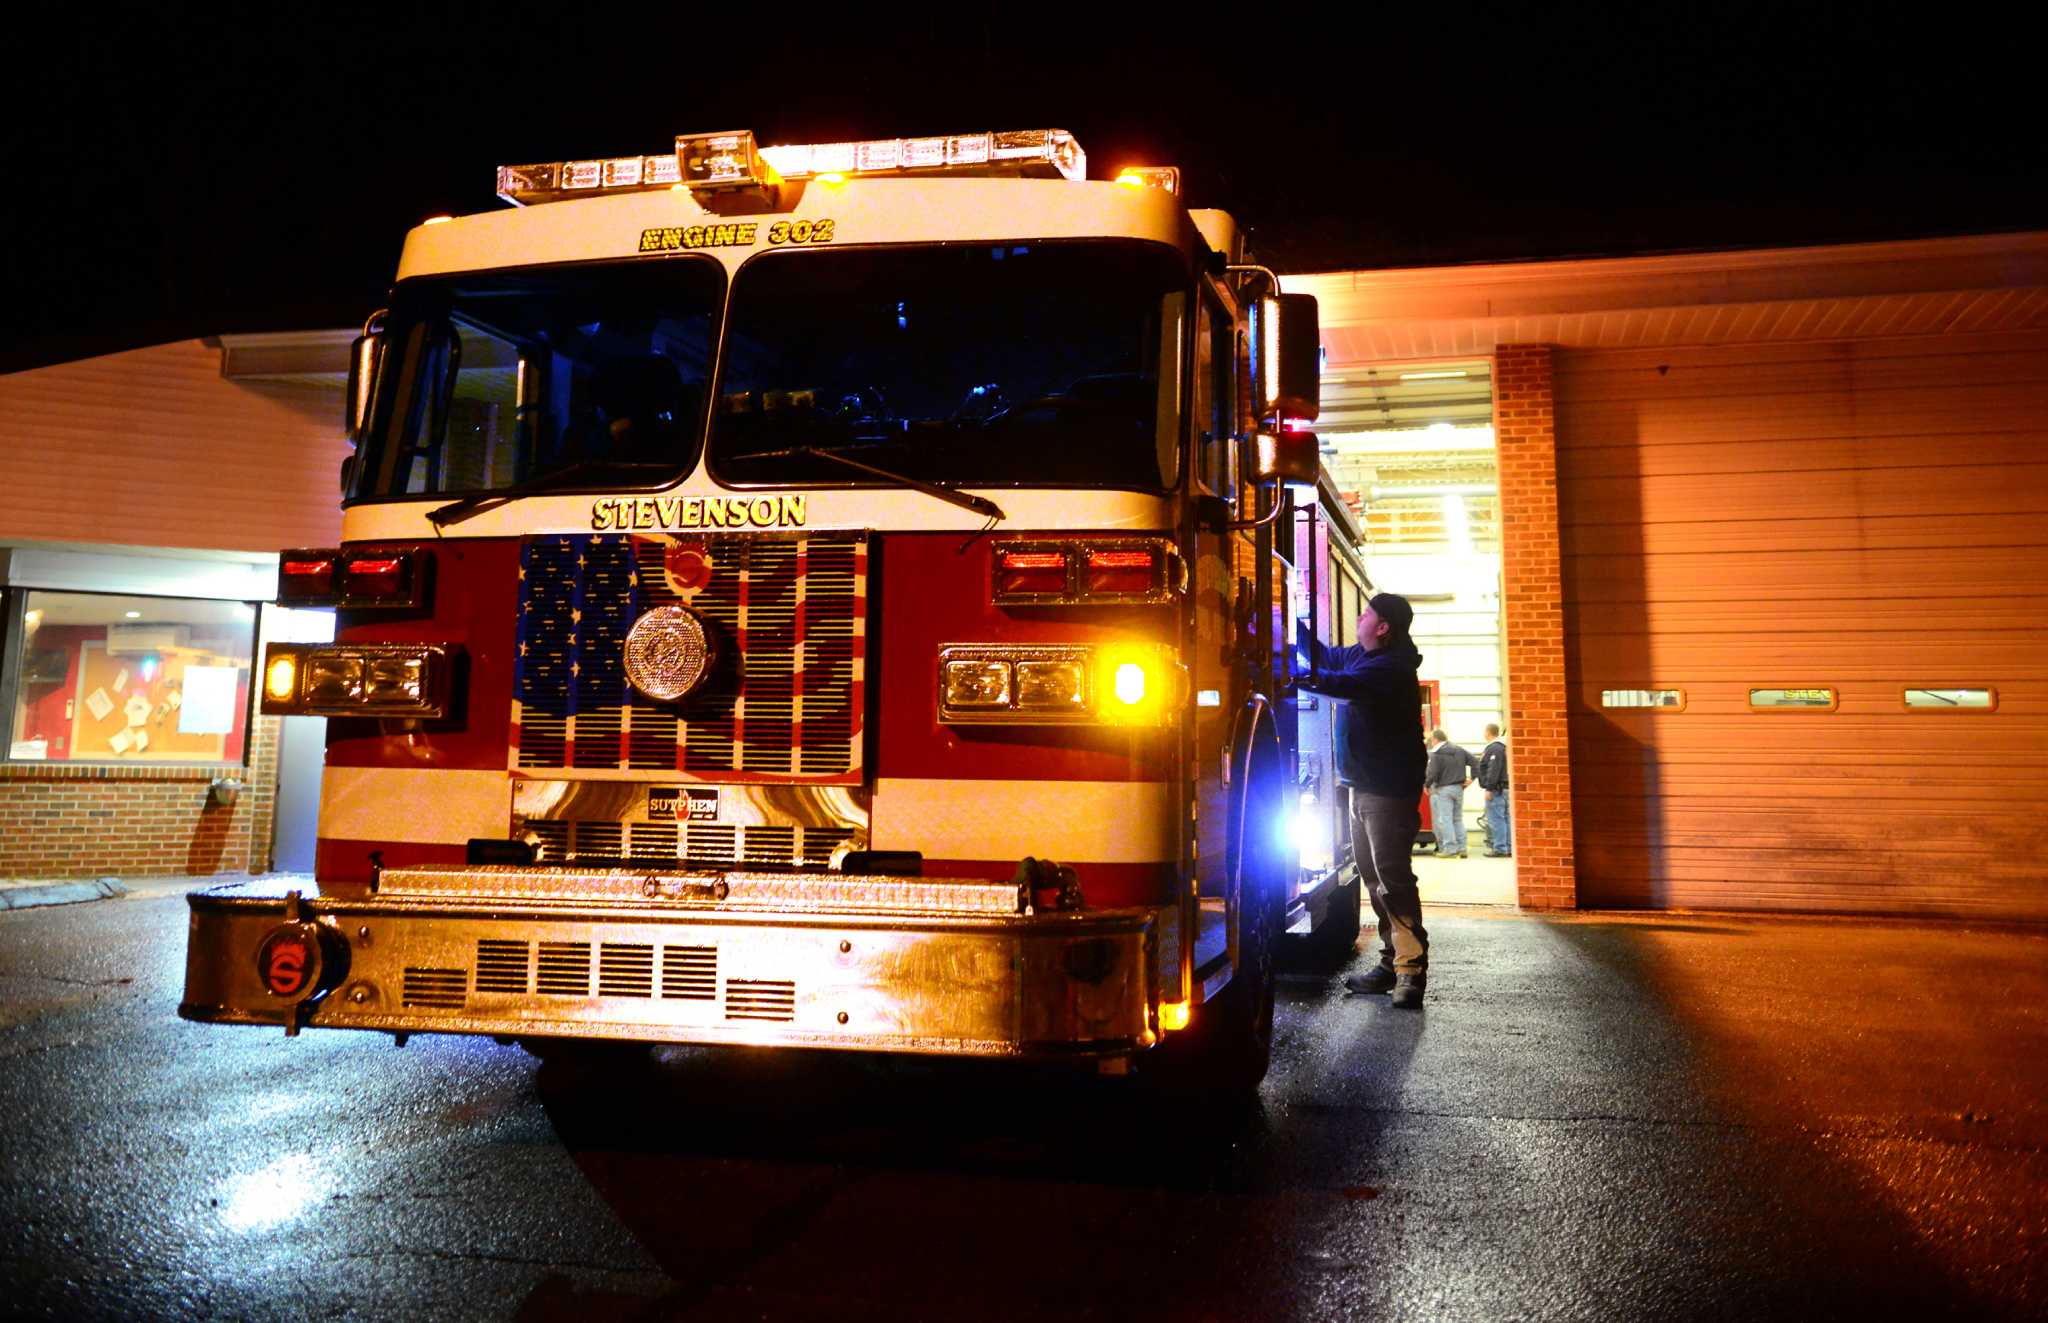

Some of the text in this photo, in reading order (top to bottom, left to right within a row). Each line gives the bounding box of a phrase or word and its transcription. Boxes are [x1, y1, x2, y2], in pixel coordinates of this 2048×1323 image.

[639, 219, 836, 252] ENGINE 302
[592, 494, 807, 530] STEVENSON
[650, 799, 718, 812] SUTPHEN
